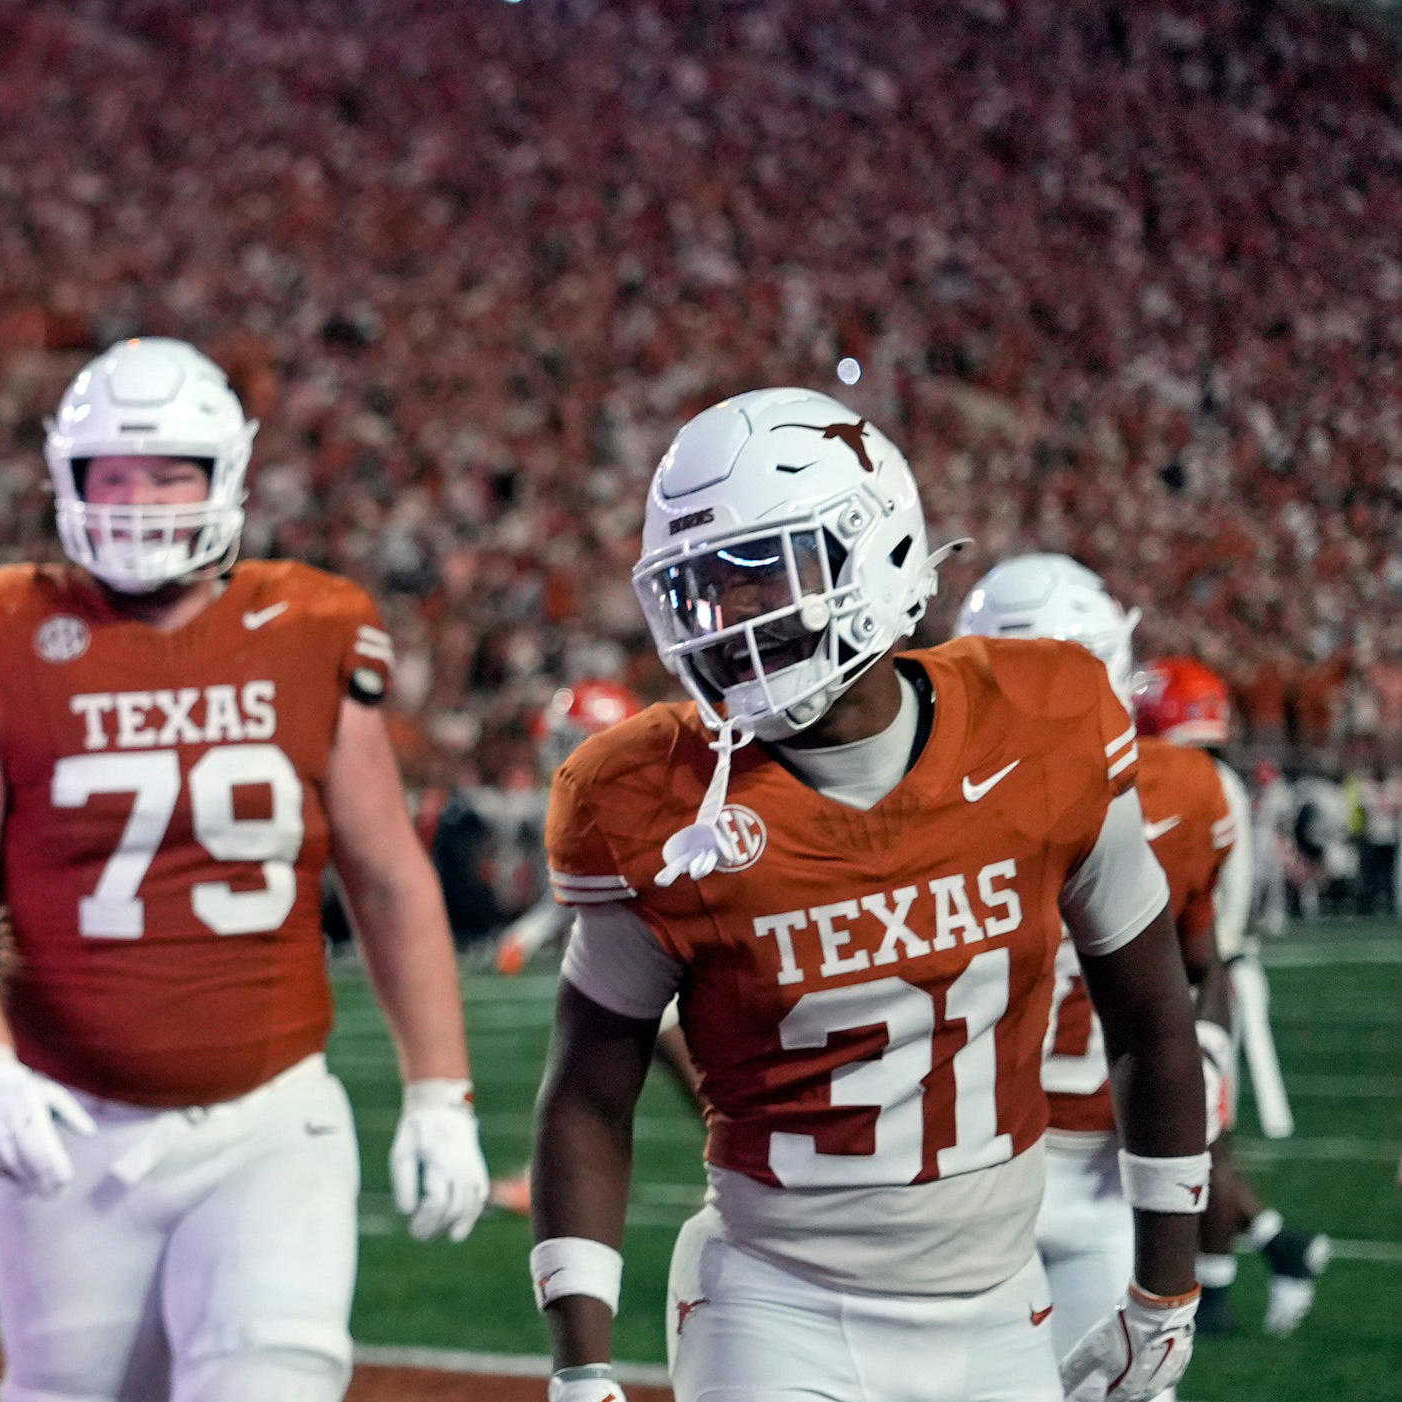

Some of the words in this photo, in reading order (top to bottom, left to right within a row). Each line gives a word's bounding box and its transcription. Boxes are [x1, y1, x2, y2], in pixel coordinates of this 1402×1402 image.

[69, 679, 277, 750] TEXAS
[50, 742, 306, 940] 79
[753, 858, 1023, 985] TEXAS
[767, 946, 1014, 1189] 31
